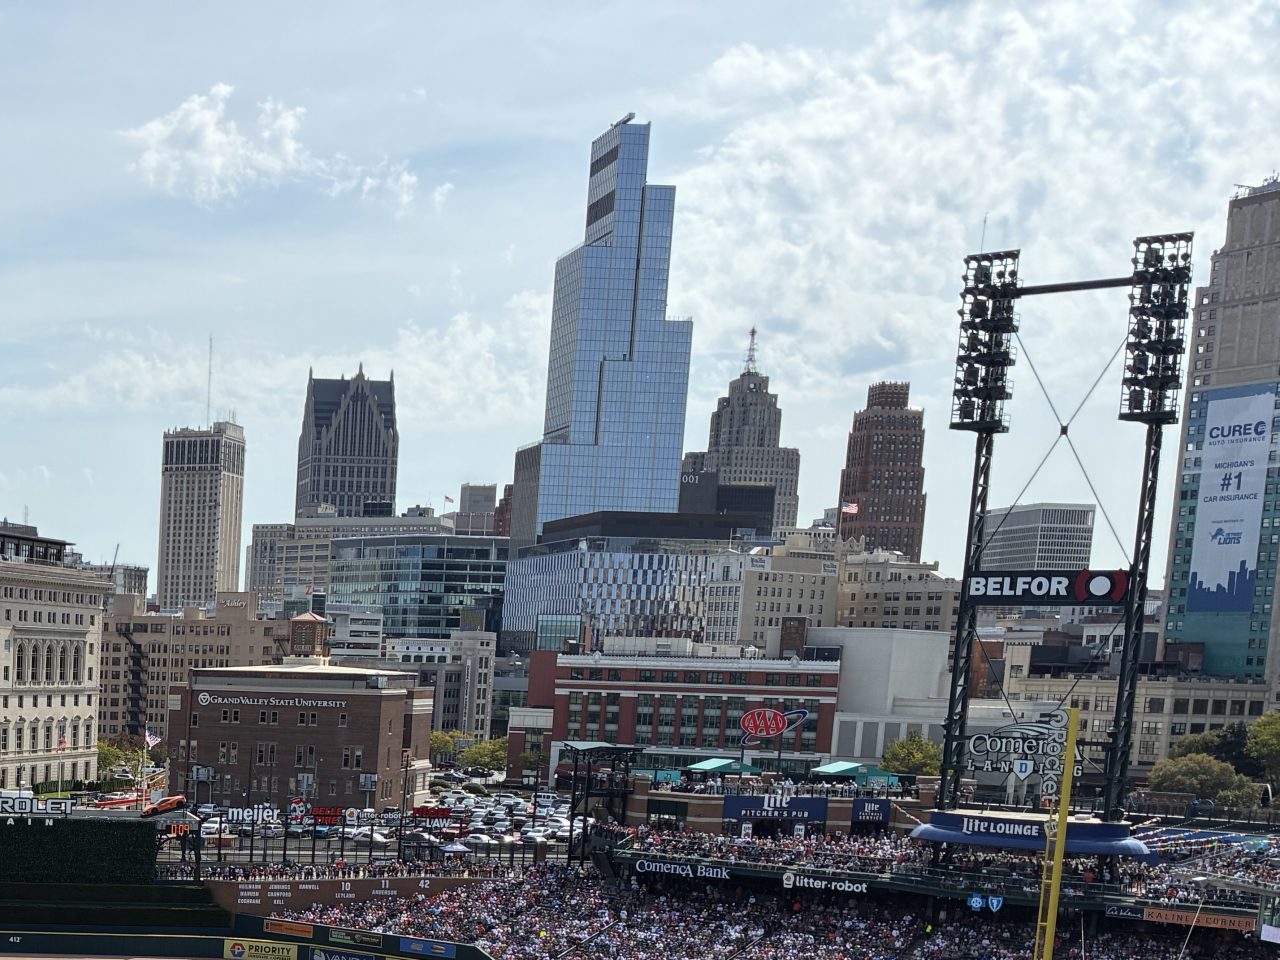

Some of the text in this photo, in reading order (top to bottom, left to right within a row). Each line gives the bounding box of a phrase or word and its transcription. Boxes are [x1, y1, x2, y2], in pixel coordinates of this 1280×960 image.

[1209, 423, 1252, 439] CURE
[1227, 436, 1266, 445] INSURANCE
[1214, 460, 1255, 469] MICHIGAN'S
[1220, 472, 1243, 491] #1
[1219, 493, 1259, 502] INSURANCE
[1217, 536, 1242, 545] LIONS
[970, 577, 1069, 597] BELFOR
[210, 695, 347, 708] GRAND VALLEY STATE UNIVERSITY
[745, 711, 786, 734] AAA
[969, 734, 1082, 760] Comer
[967, 759, 1082, 777] LANDIG
[762, 793, 791, 810] Lite
[864, 803, 880, 812] Lite
[228, 804, 281, 825] meijer
[312, 807, 343, 815] BELLE
[426, 818, 451, 828] LAW
[962, 818, 1039, 836] Lite LOUNGE
[696, 864, 731, 879] Bank
[341, 882, 351, 891] 10
[381, 880, 389, 888] 11
[418, 880, 430, 889] 42
[1205, 917, 1252, 928] CORNER
[248, 944, 292, 956] PRIORITY
